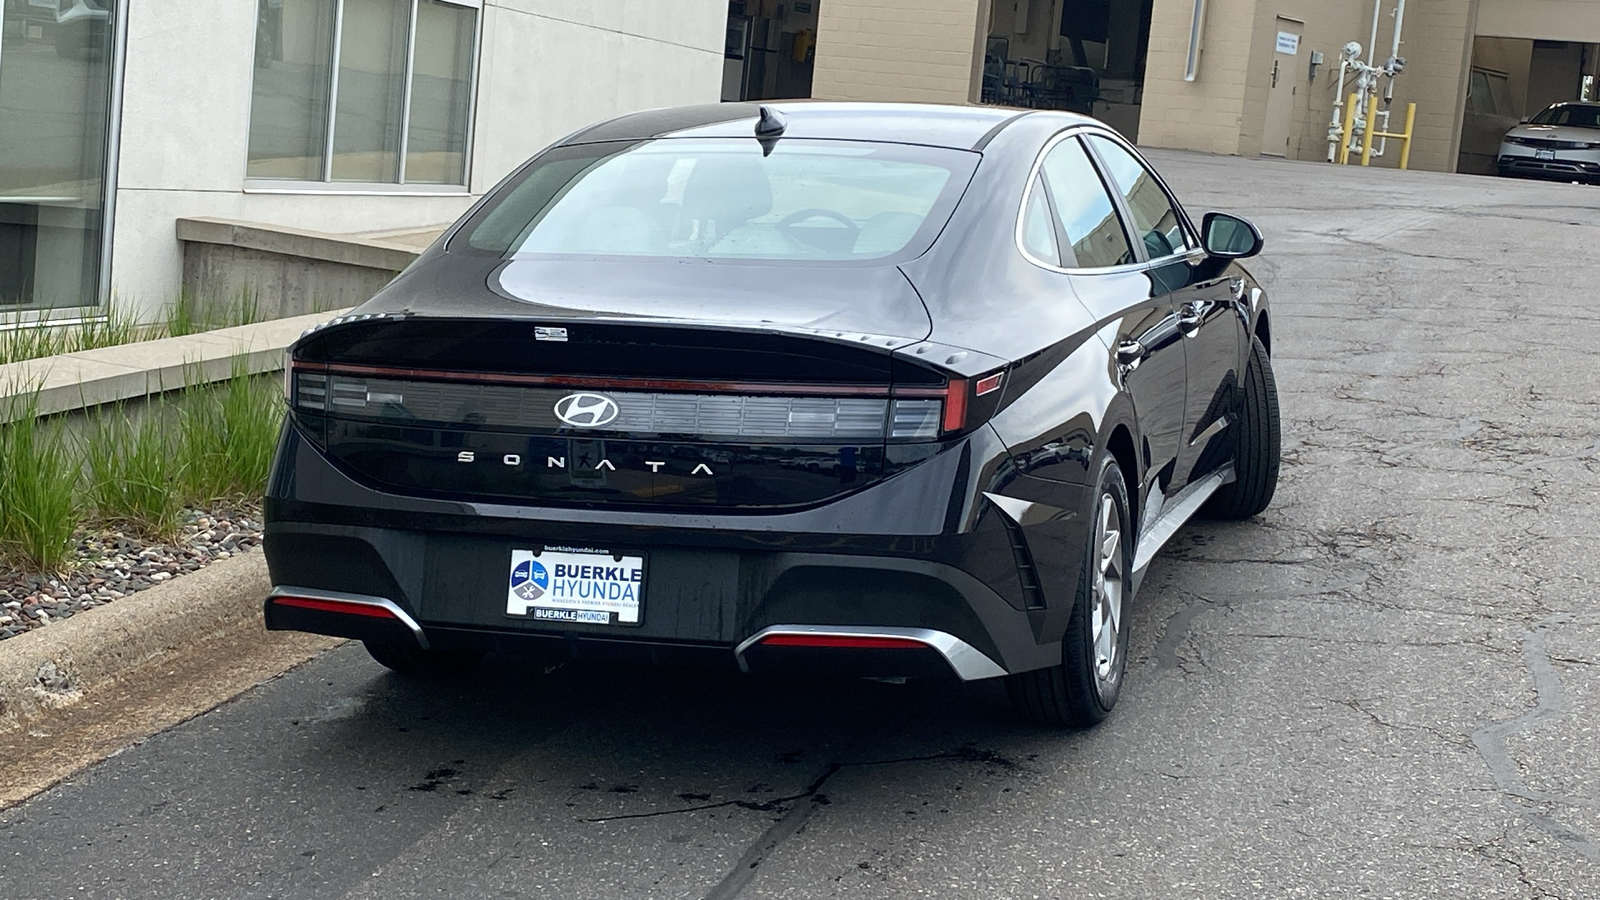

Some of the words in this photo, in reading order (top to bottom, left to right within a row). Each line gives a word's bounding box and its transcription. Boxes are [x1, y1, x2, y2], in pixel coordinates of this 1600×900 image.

[457, 451, 714, 476] SONATA
[544, 545, 610, 554] buerklehyundai.com
[554, 563, 642, 582] BUERKLE
[552, 579, 641, 602] HYUNDAI
[535, 609, 577, 620] BUERKLE
[577, 612, 608, 622] HYUNDAI
